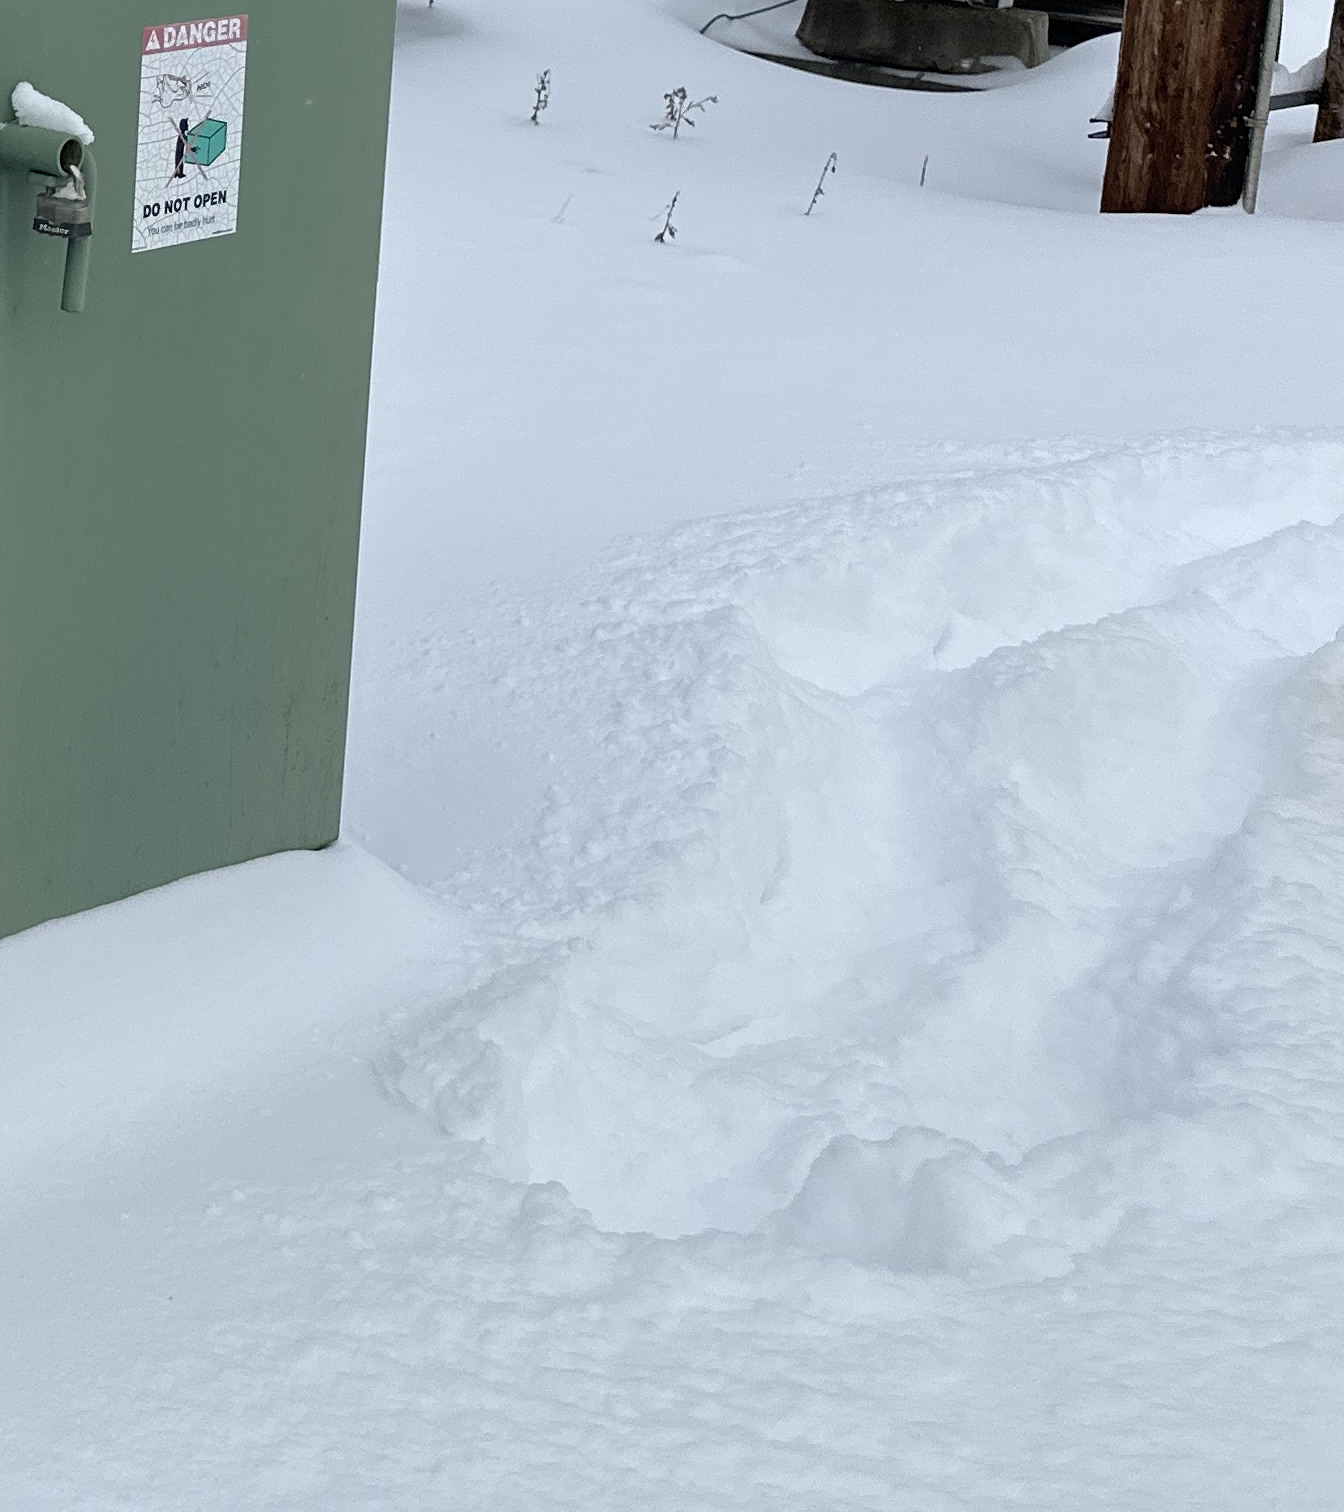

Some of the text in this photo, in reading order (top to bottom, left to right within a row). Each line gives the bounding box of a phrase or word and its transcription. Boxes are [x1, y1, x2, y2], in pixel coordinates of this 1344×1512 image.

[163, 18, 242, 49] DANGER
[143, 190, 227, 218] DO NOT OPEN
